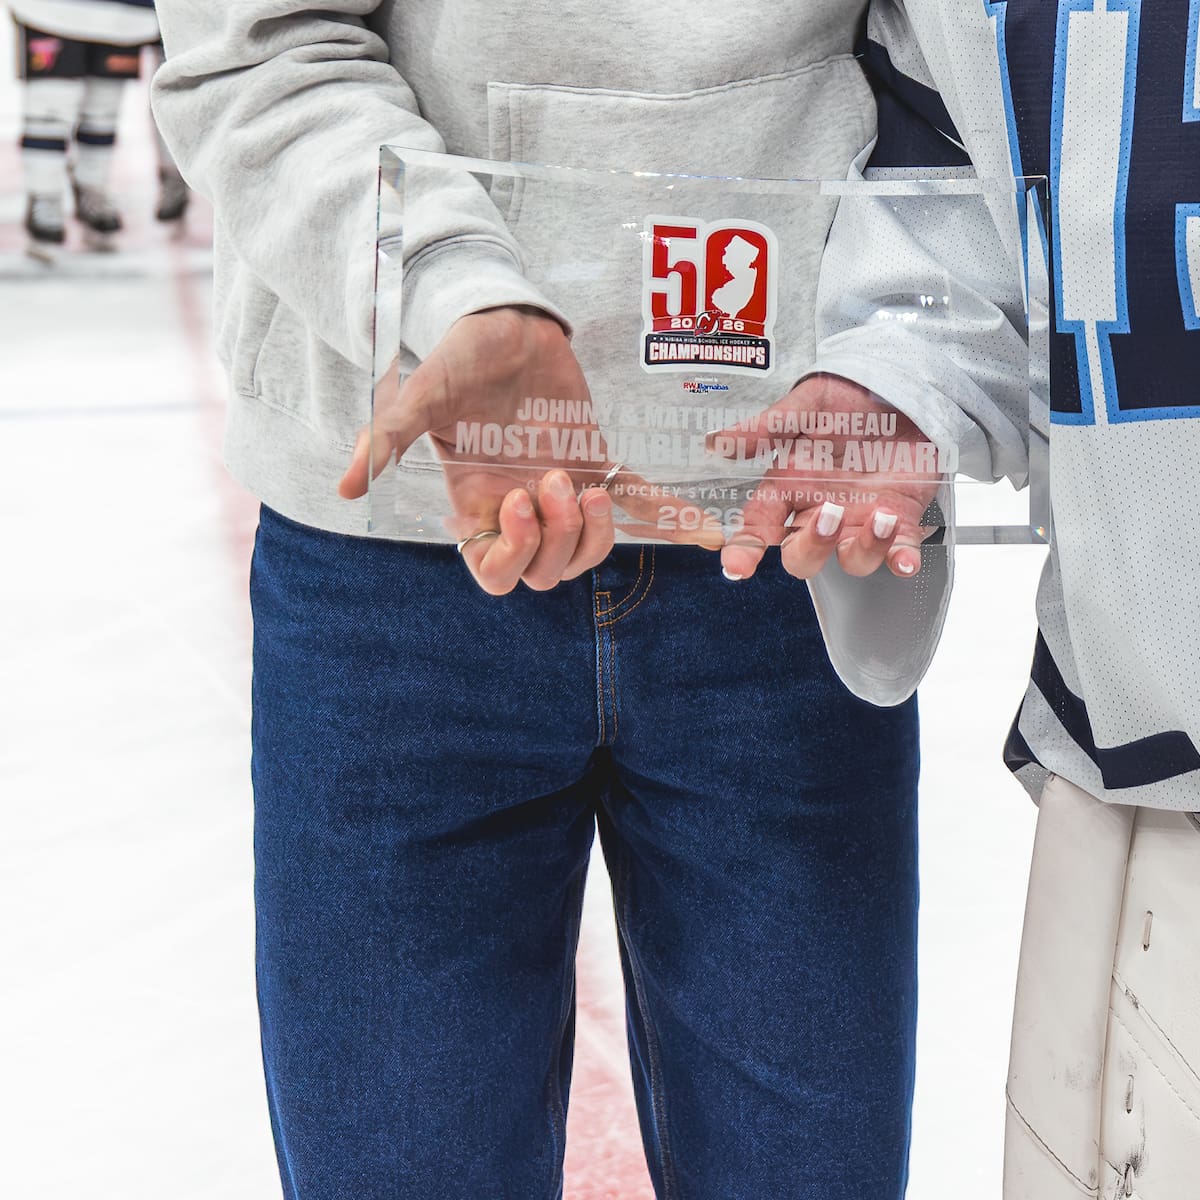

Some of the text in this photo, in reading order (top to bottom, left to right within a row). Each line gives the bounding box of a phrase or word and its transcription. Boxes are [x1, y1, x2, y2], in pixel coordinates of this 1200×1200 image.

[651, 224, 768, 324] 50
[670, 318, 745, 331] 20 26
[649, 342, 766, 365] CHAMPIONSHIPS
[517, 398, 613, 425] JOHNNY
[646, 404, 761, 433] MATTHEW
[767, 410, 897, 437] GAUDREAU
[455, 420, 960, 473] MOST VALUABLE PLAYER AWARD
[614, 483, 681, 498] HOCKEY
[688, 487, 739, 500] STATE
[745, 489, 879, 504] CHAMPIONSHIP
[656, 505, 745, 532] 2026
